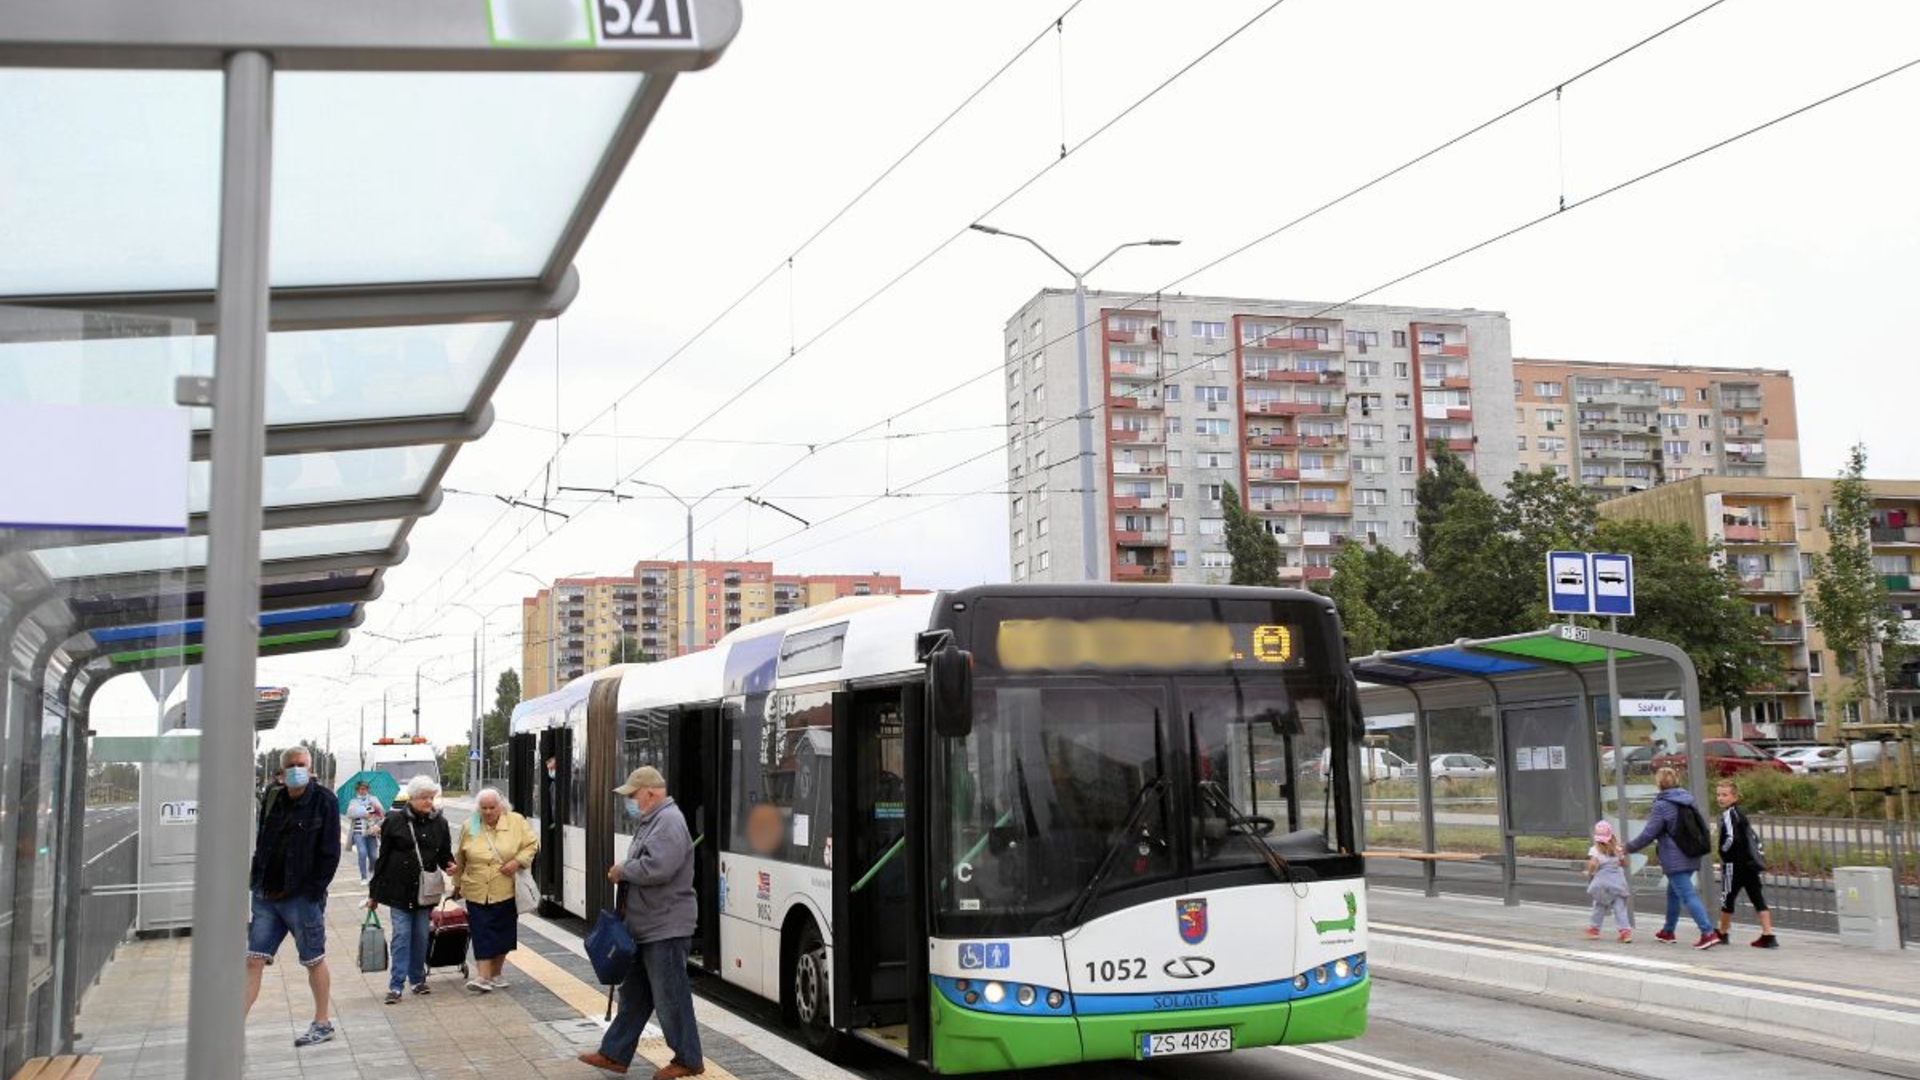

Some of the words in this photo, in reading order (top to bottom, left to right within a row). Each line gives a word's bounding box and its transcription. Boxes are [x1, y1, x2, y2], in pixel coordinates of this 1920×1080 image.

[958, 862, 973, 883] C
[1086, 957, 1147, 982] 1052
[1153, 993, 1219, 1009] SOLARIS
[1153, 1035, 1175, 1053] ZS
[1181, 1031, 1228, 1050] 4496S
